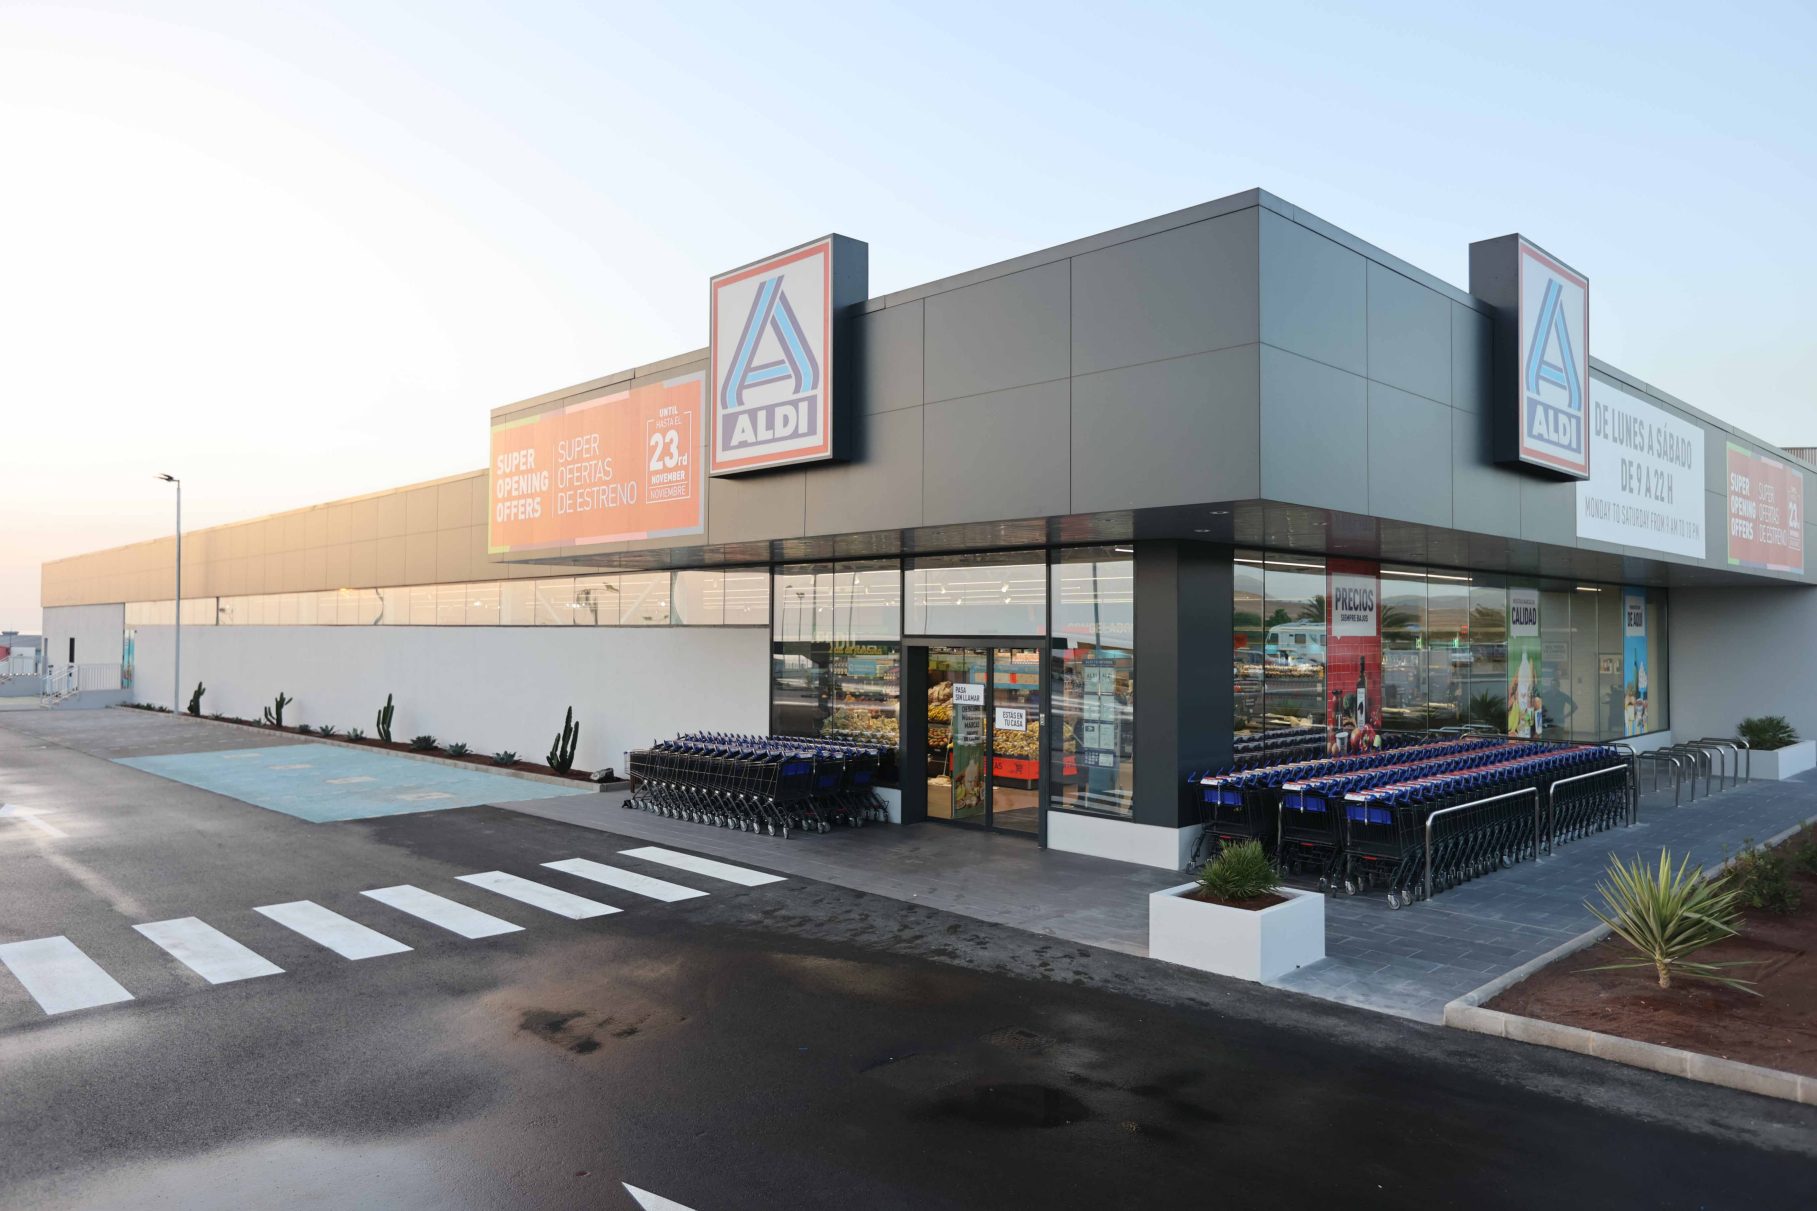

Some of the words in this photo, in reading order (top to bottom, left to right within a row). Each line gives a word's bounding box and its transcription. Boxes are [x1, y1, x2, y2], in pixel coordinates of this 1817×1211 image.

[656, 418, 673, 429] HASTA
[659, 406, 678, 418] UNTIL
[730, 401, 809, 446] ALDI
[1532, 404, 1577, 449] ALDI
[1595, 401, 1609, 439] DE
[1612, 408, 1645, 452] LUNES
[1648, 423, 1654, 456] A
[1656, 422, 1692, 470] SÁBADO
[558, 433, 599, 463] SUPER
[496, 448, 535, 475] SUPER
[558, 457, 612, 488] OFERTAS
[496, 470, 549, 498] OPENING
[651, 470, 685, 484] NOVEMBER
[1621, 458, 1633, 493] DE
[1636, 463, 1641, 495] 9
[1645, 466, 1652, 498] A
[1654, 468, 1665, 502] 22
[1667, 473, 1673, 505] H
[1731, 472, 1750, 496] SUPER
[557, 492, 573, 514] DE
[576, 481, 637, 512] ESTRENO
[650, 486, 686, 499] NOVIEMBRE
[496, 497, 541, 522] OFFERS
[1585, 496, 1610, 521] MONDAY
[1613, 503, 1620, 523] TO
[1622, 505, 1650, 529] SATURDAY
[1651, 511, 1665, 533] FROM
[1731, 494, 1756, 519] OPENING
[1731, 518, 1754, 540] OFFERS
[1335, 587, 1374, 612] PRECIOS
[1512, 607, 1537, 625] CALIDAD
